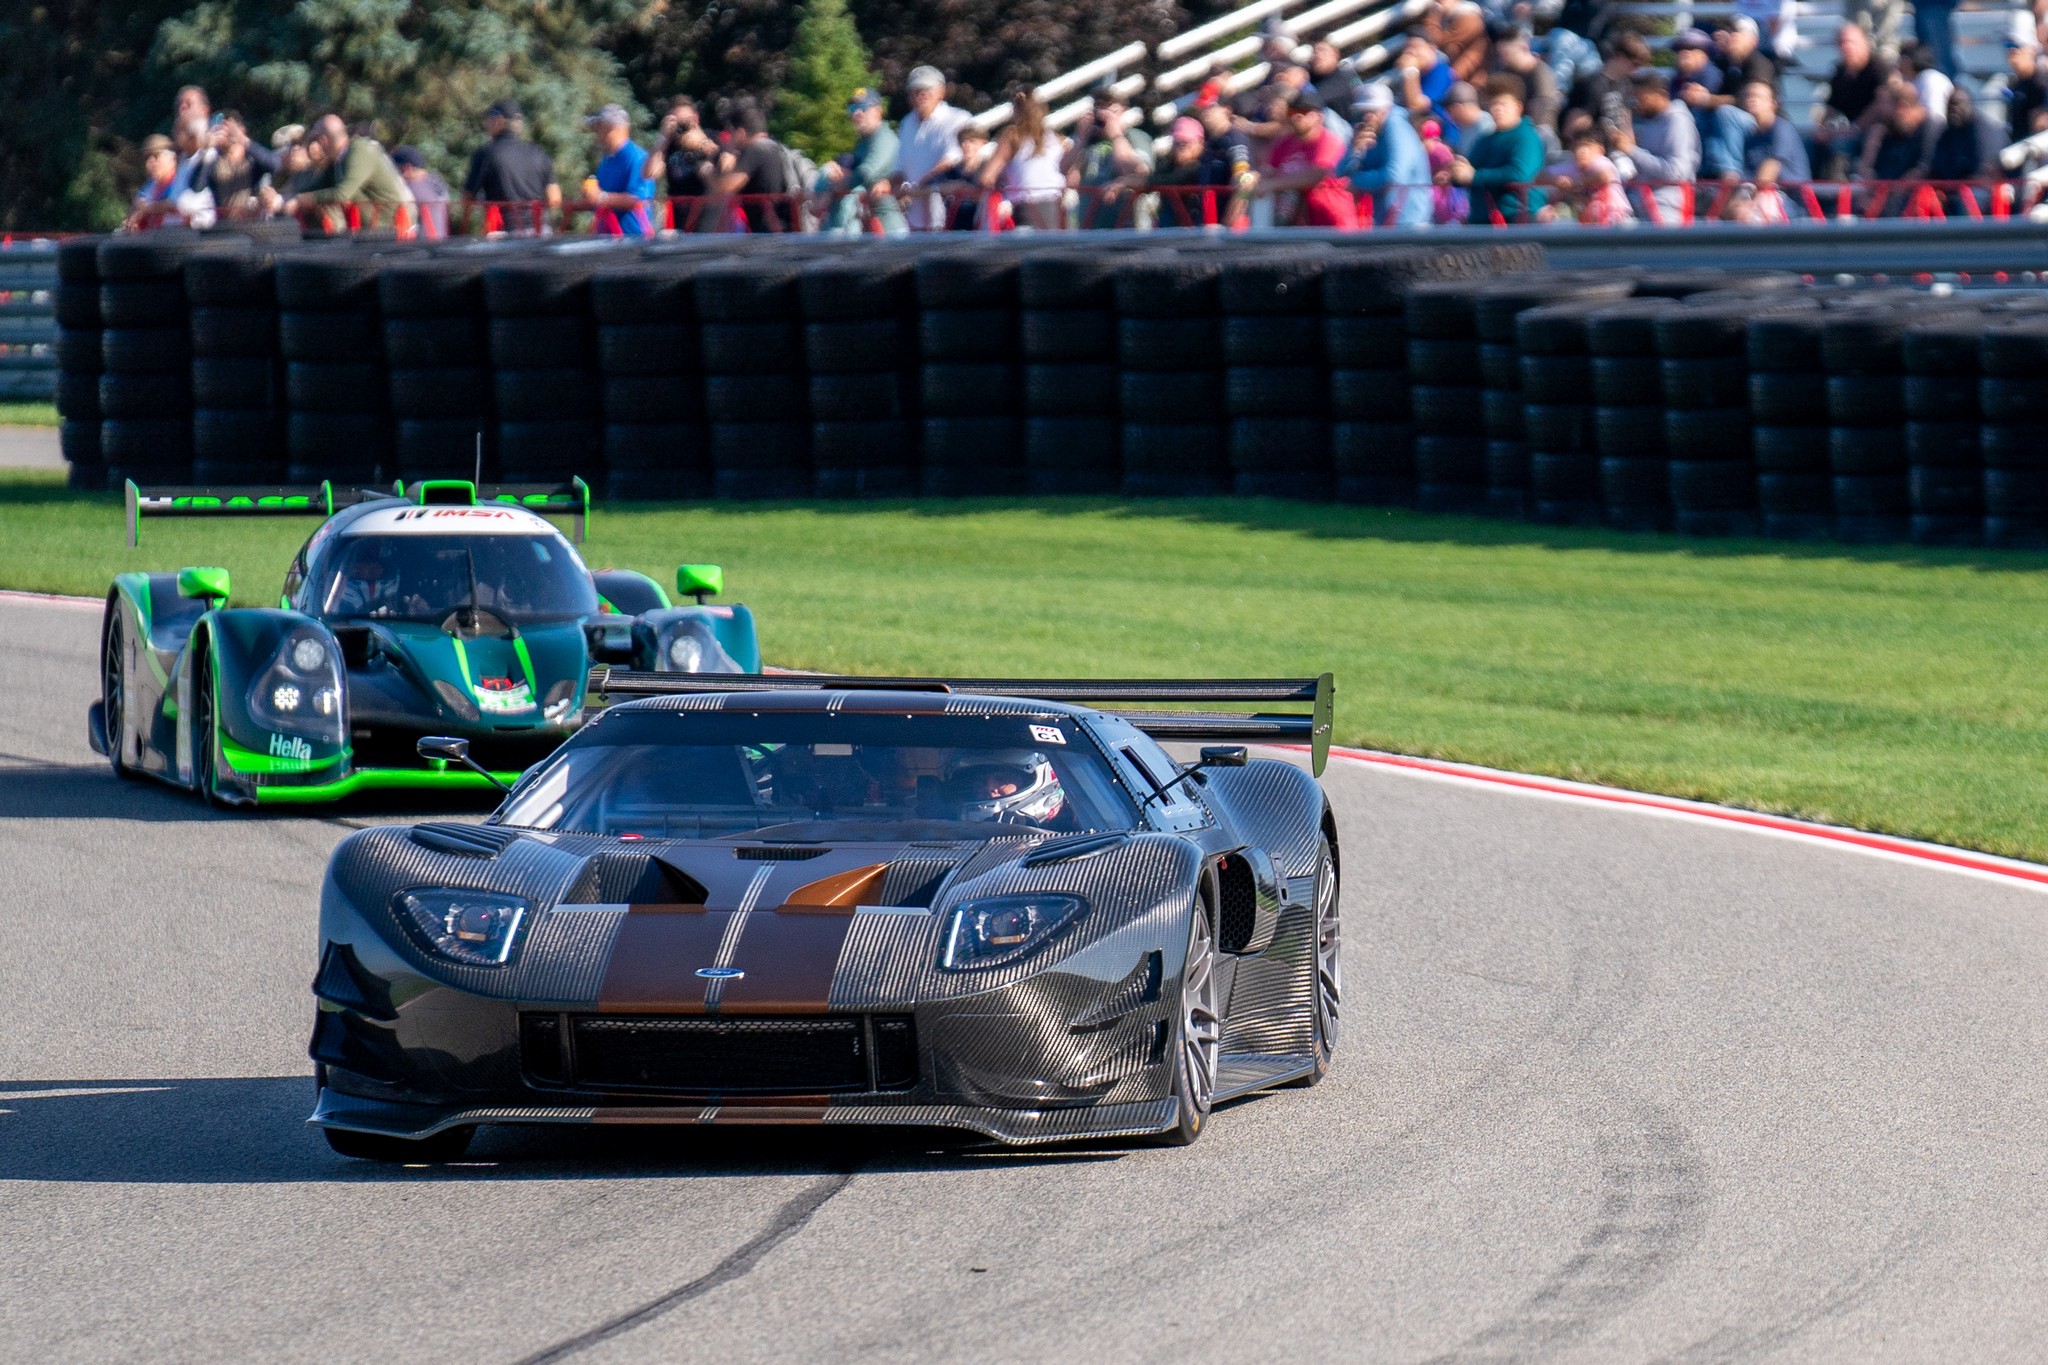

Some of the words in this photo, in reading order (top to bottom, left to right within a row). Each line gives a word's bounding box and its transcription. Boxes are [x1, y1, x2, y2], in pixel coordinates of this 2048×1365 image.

[433, 509, 514, 520] IMSA
[1038, 733, 1060, 741] C1
[269, 732, 312, 760] Hella
